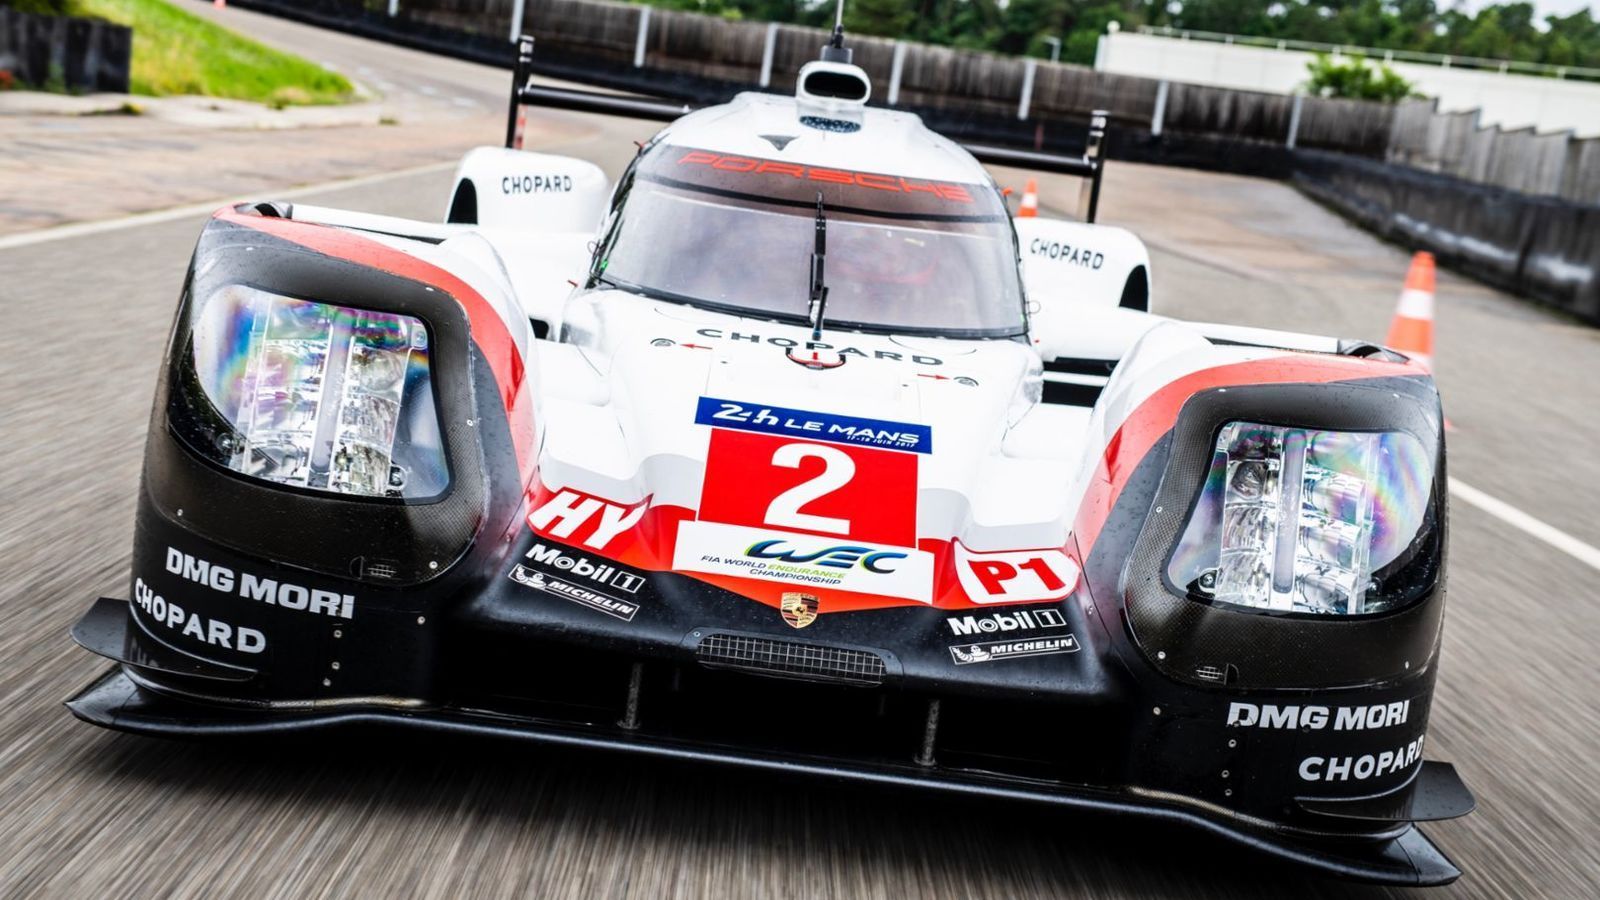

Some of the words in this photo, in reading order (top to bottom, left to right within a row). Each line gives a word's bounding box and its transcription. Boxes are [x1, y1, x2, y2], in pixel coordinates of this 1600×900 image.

[501, 175, 572, 195] CHOPARD
[677, 151, 975, 204] PORSCHE
[1030, 238, 1104, 270] CHOPARD
[696, 328, 944, 366] CHOPARD
[784, 418, 825, 431] LE
[828, 424, 919, 444] MANS
[763, 442, 856, 535] 2
[527, 490, 649, 550] HY
[525, 543, 615, 583] Mobil
[701, 555, 721, 564] FIA
[724, 558, 767, 569] WORLD
[767, 563, 848, 579] ENDURANCE
[744, 539, 908, 574] WEC
[165, 546, 235, 593] DMG
[239, 573, 355, 619] MORI
[749, 568, 841, 585] CHAMPIONSHIP
[967, 557, 1066, 595] P1
[135, 577, 266, 654] CHOPARD
[548, 581, 634, 615] MICHELIN
[947, 610, 1035, 636] Mobil
[990, 637, 1073, 654] MICHELIN
[1226, 702, 1329, 730] DMG
[1333, 700, 1410, 730] MORI
[1298, 734, 1424, 781] CHOPARD
